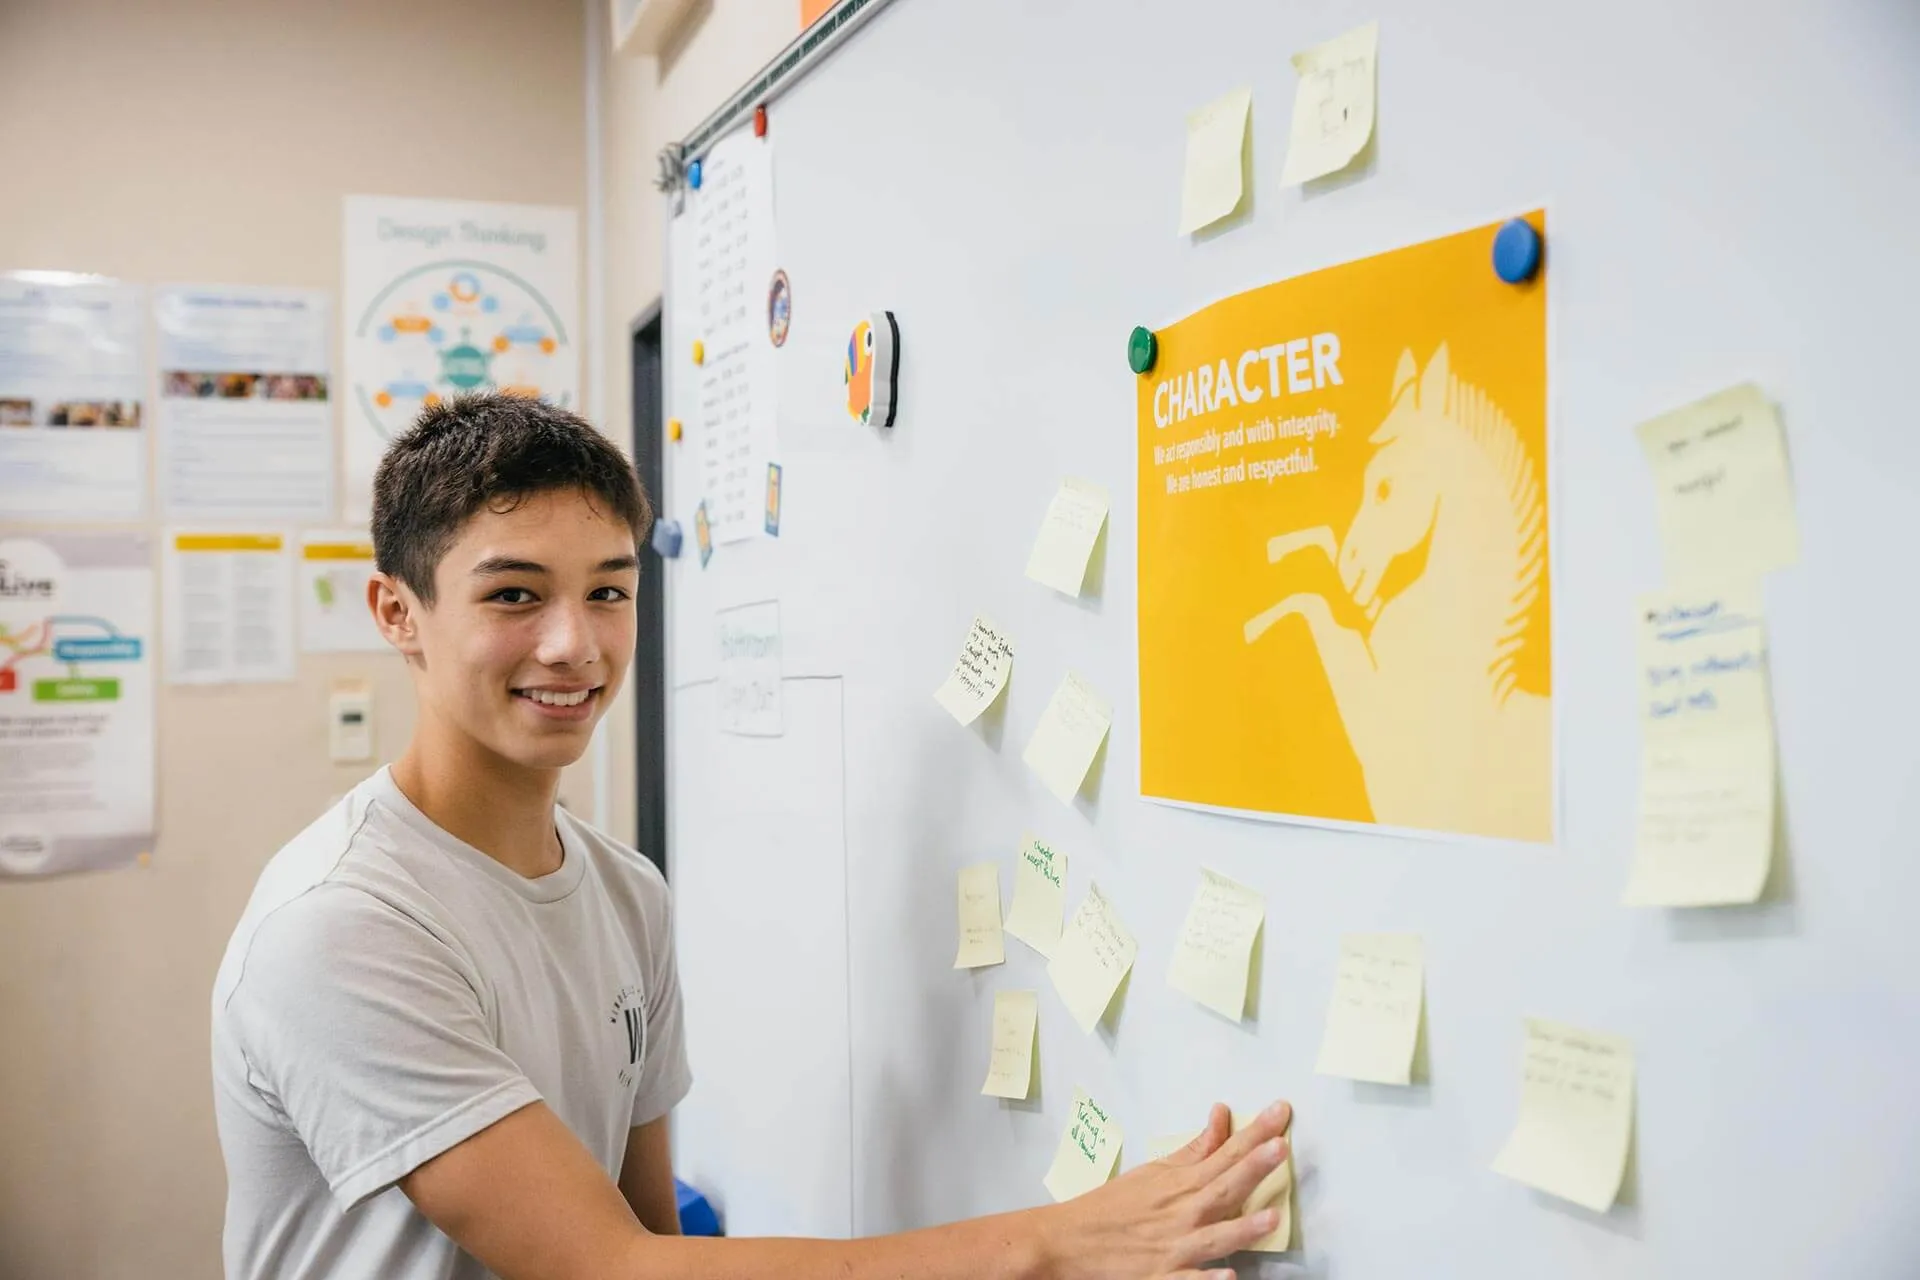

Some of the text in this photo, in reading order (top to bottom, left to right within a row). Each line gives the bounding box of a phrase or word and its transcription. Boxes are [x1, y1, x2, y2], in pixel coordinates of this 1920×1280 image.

[1153, 332, 1344, 429] CHARACTER
[1154, 408, 1342, 466] We act responsibly and with integrity.
[1166, 447, 1319, 495] We are honest and respectful.
